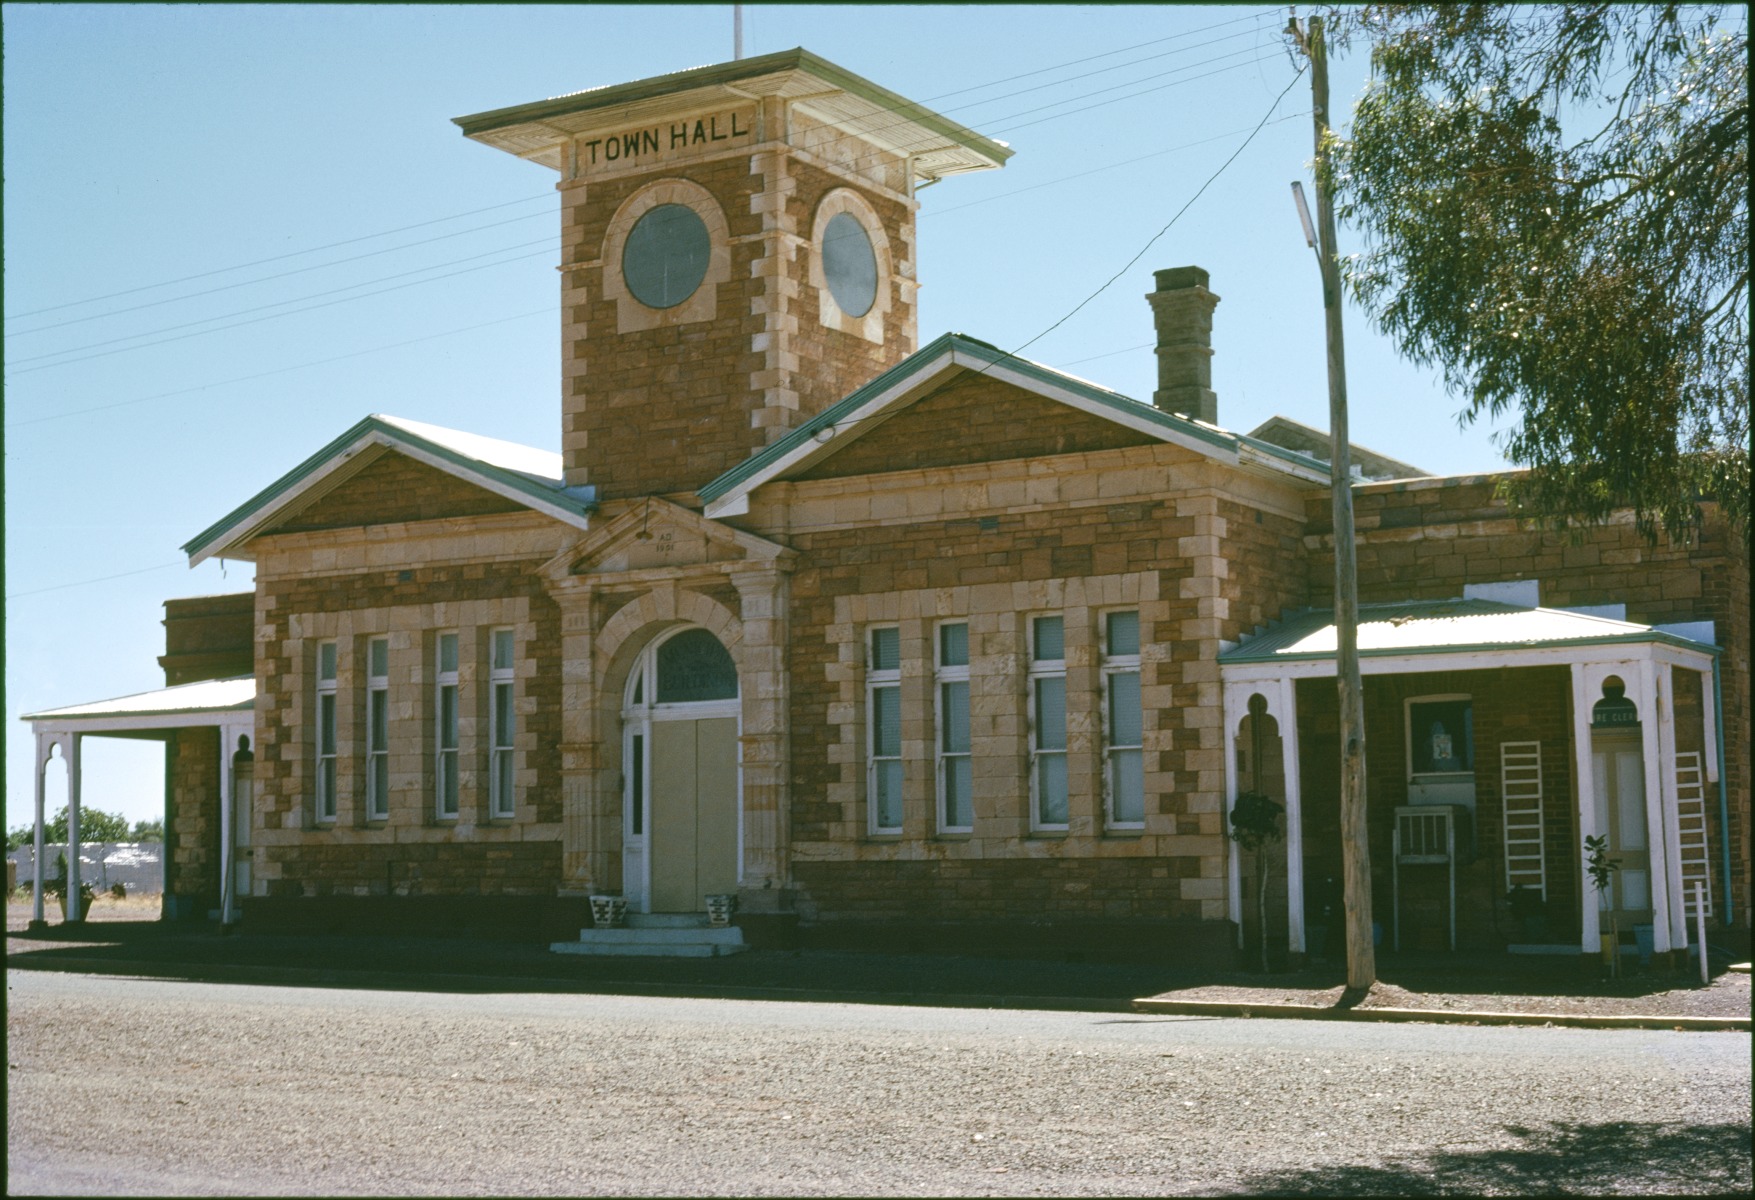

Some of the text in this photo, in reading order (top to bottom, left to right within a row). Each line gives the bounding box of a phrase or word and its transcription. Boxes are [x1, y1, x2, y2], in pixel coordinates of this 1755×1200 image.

[585, 112, 748, 164] TOWN HALL
[1612, 713, 1634, 722] CLER
